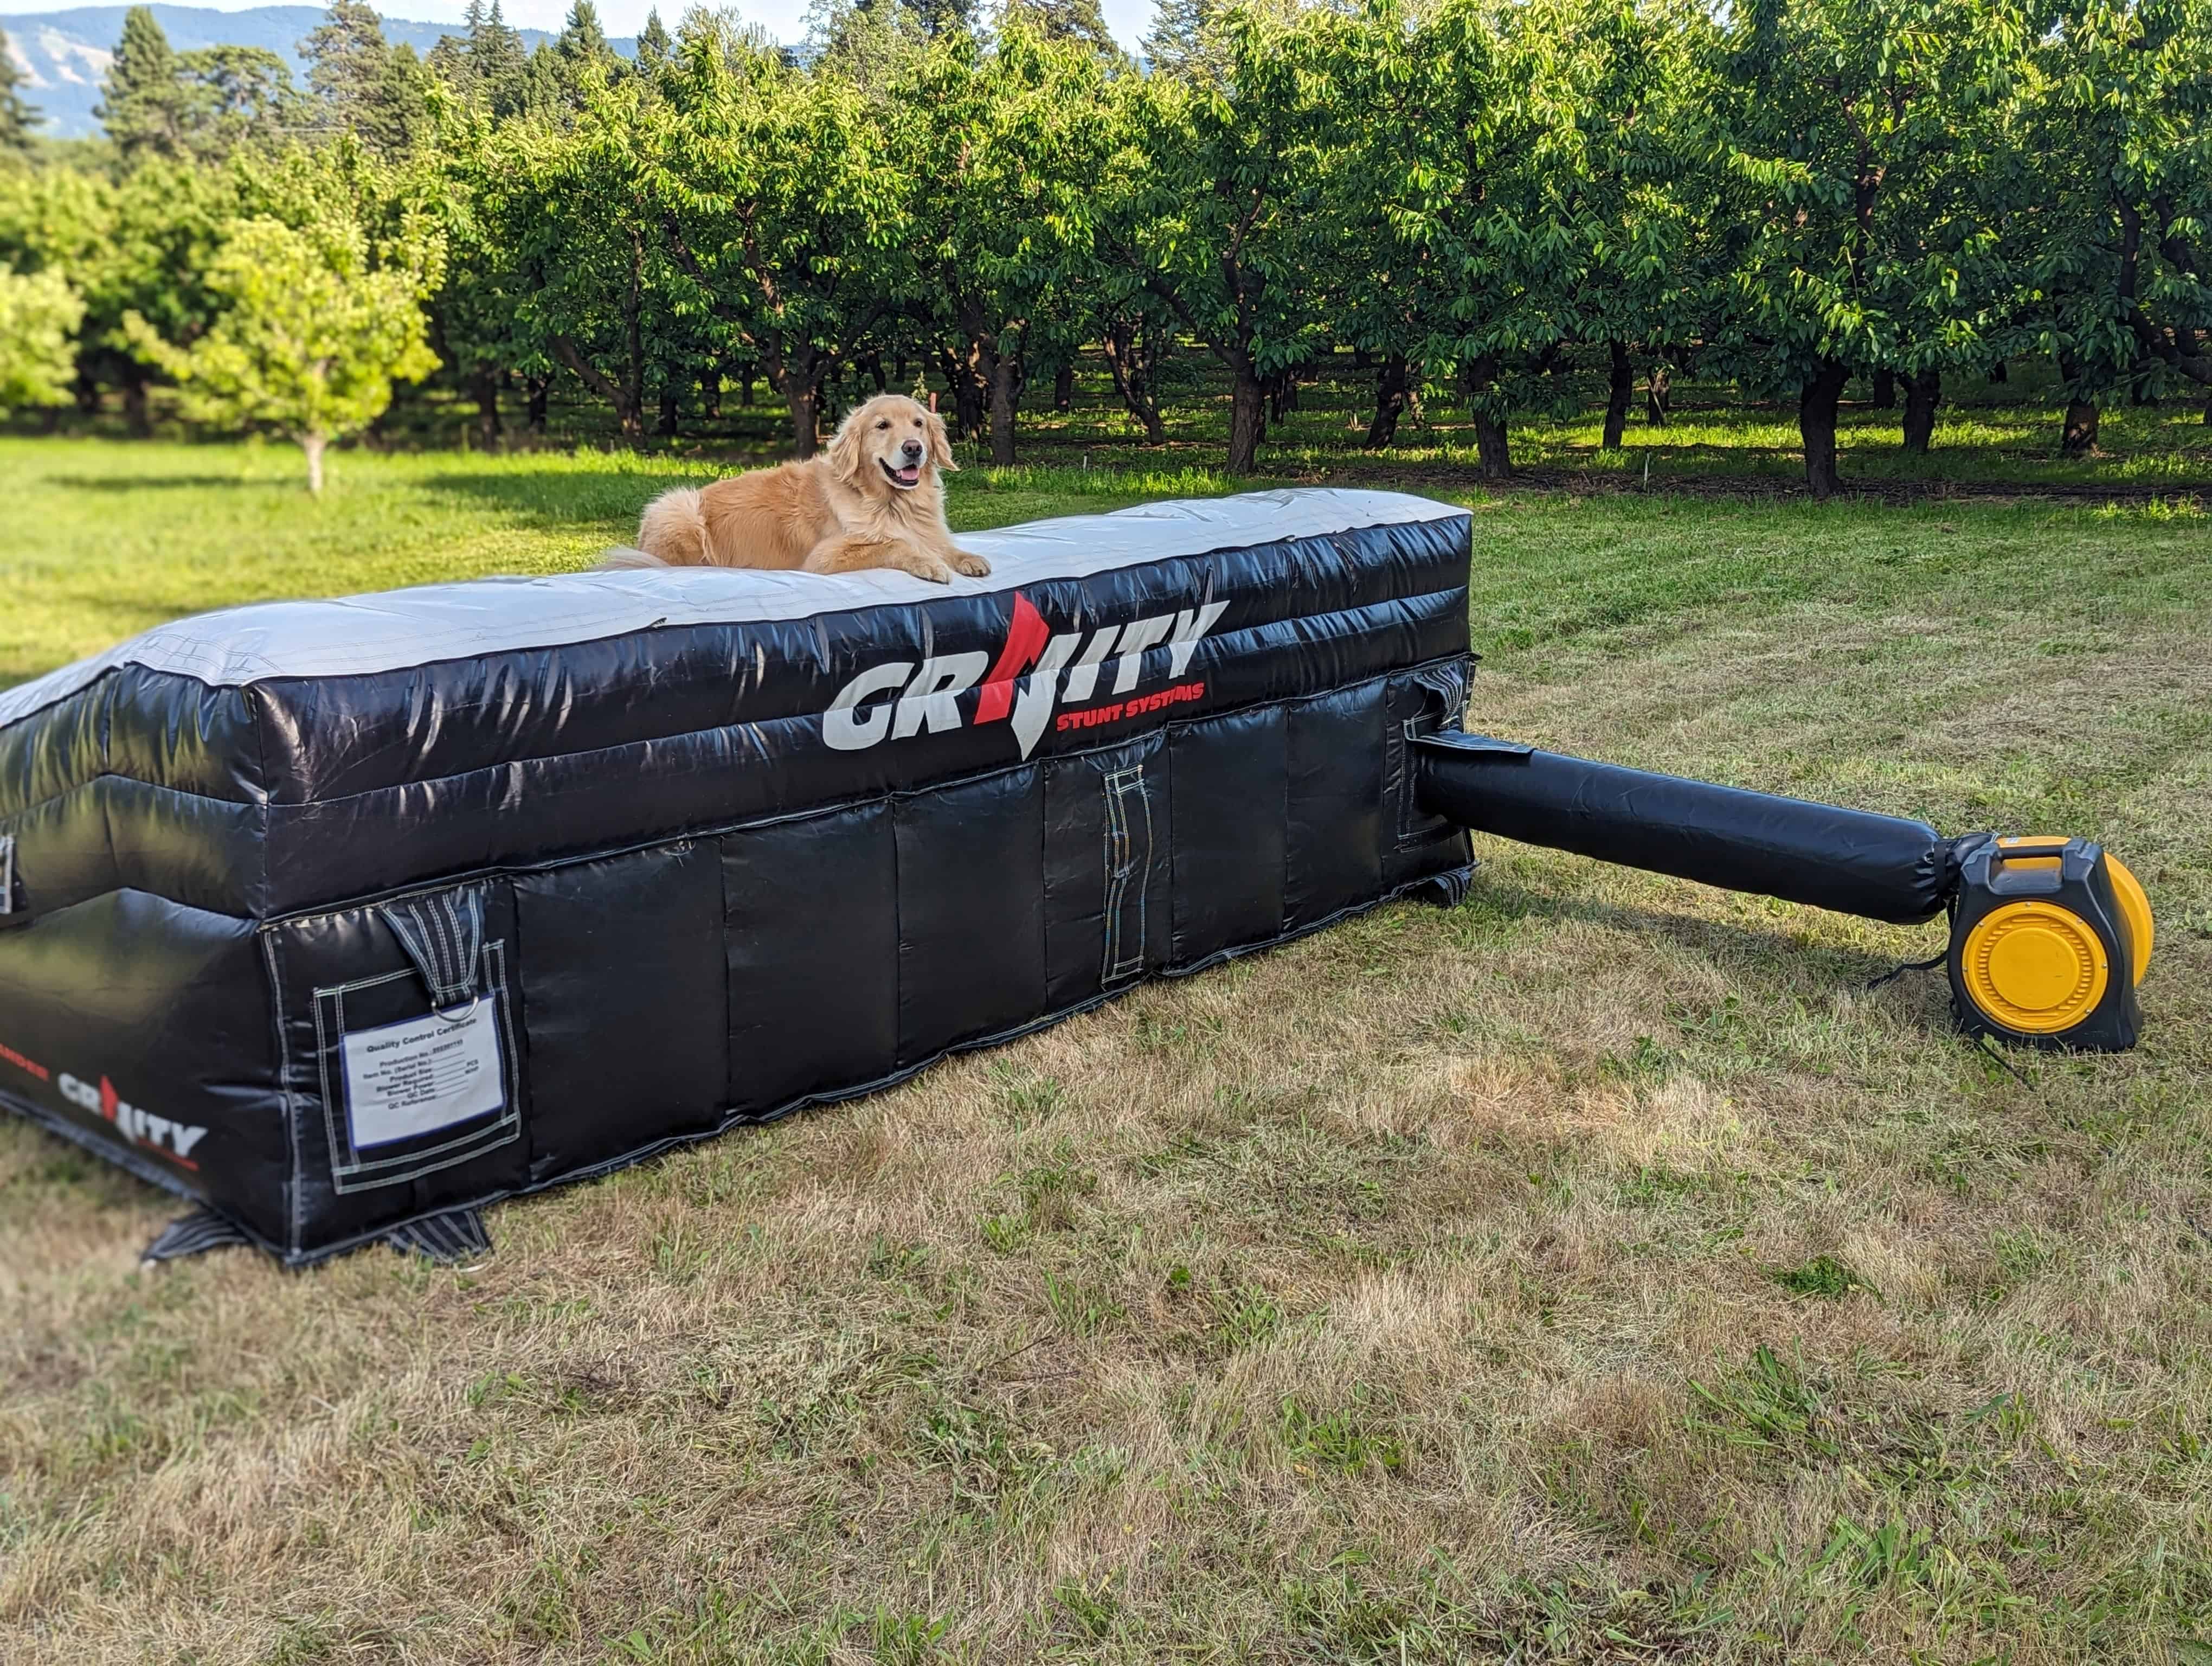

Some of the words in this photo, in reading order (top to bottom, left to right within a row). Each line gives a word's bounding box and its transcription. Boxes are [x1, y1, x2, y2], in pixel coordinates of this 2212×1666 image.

[822, 591, 1230, 761] GRAVITY
[1057, 704, 1123, 732] STUNT
[367, 1040, 400, 1053] Quality
[403, 1030, 434, 1045] Control
[436, 1018, 477, 1036] Certificate
[380, 1055, 417, 1067] Production
[376, 1083, 401, 1093] Blower
[467, 1059, 479, 1067] PCS
[389, 1072, 416, 1082] Product
[387, 1088, 411, 1097] Blower
[407, 1091, 418, 1099] QC
[388, 1101, 400, 1110] QC
